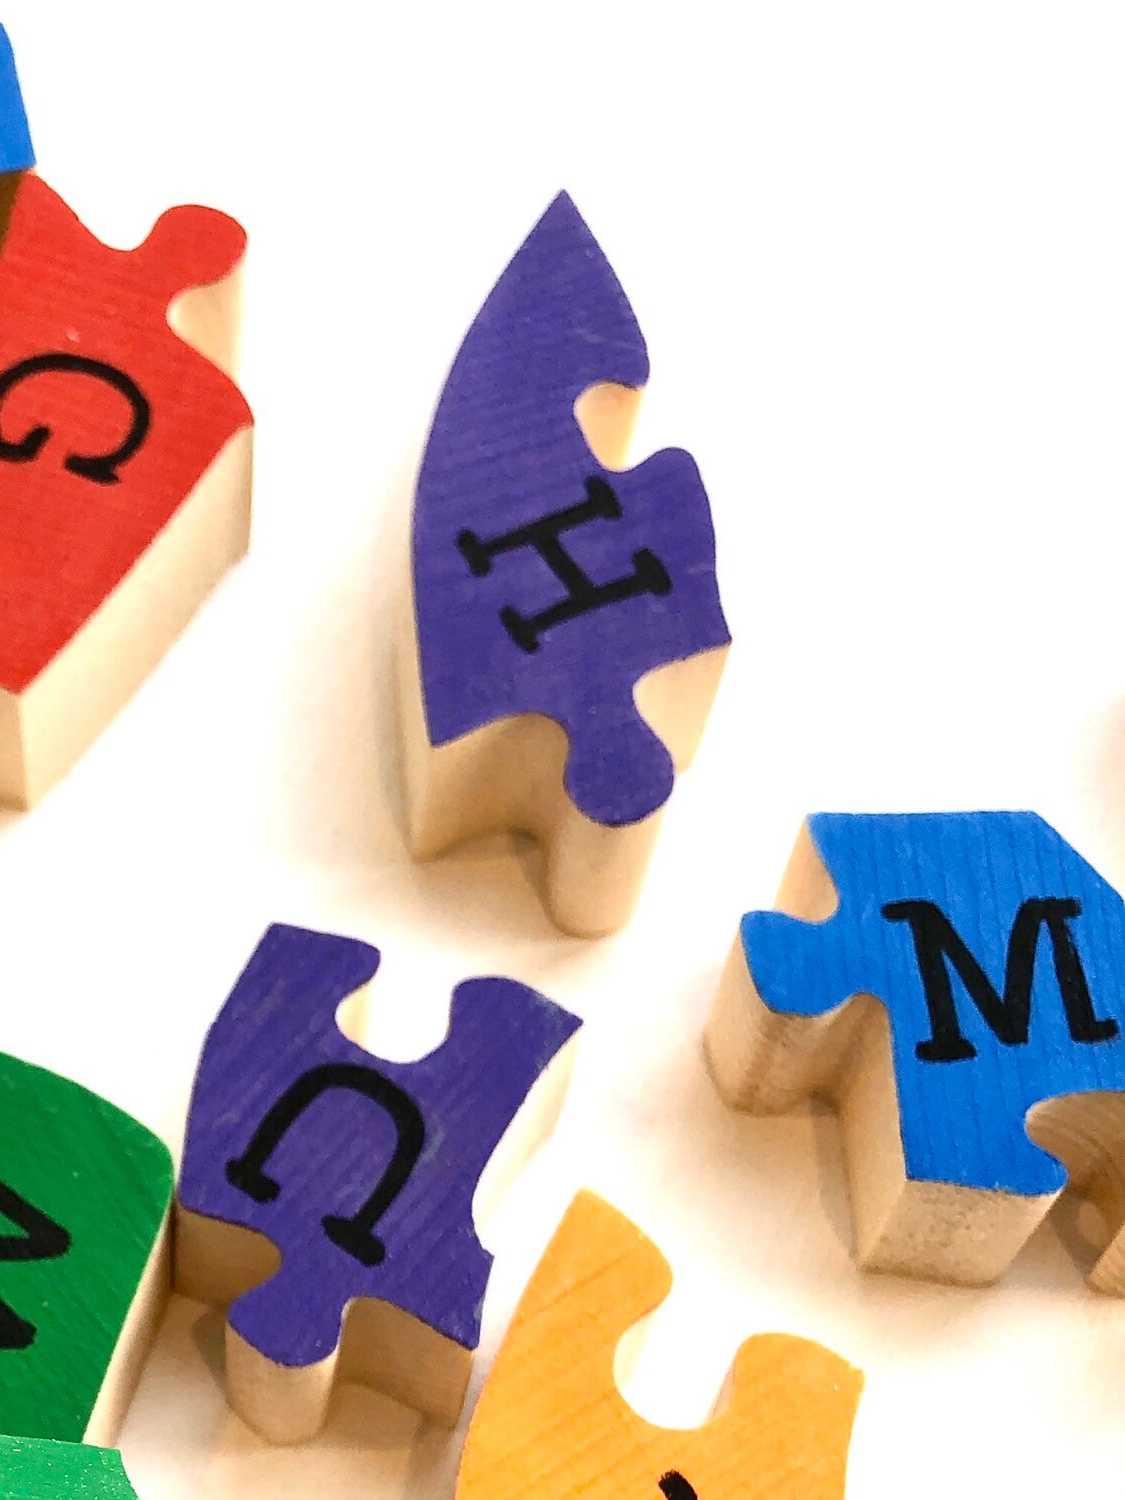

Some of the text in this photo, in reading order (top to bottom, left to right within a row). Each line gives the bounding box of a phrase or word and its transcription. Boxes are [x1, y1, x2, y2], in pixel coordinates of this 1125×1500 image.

[454, 473, 675, 657] H
[880, 895, 1121, 1065] M
[222, 1059, 430, 1270] U
